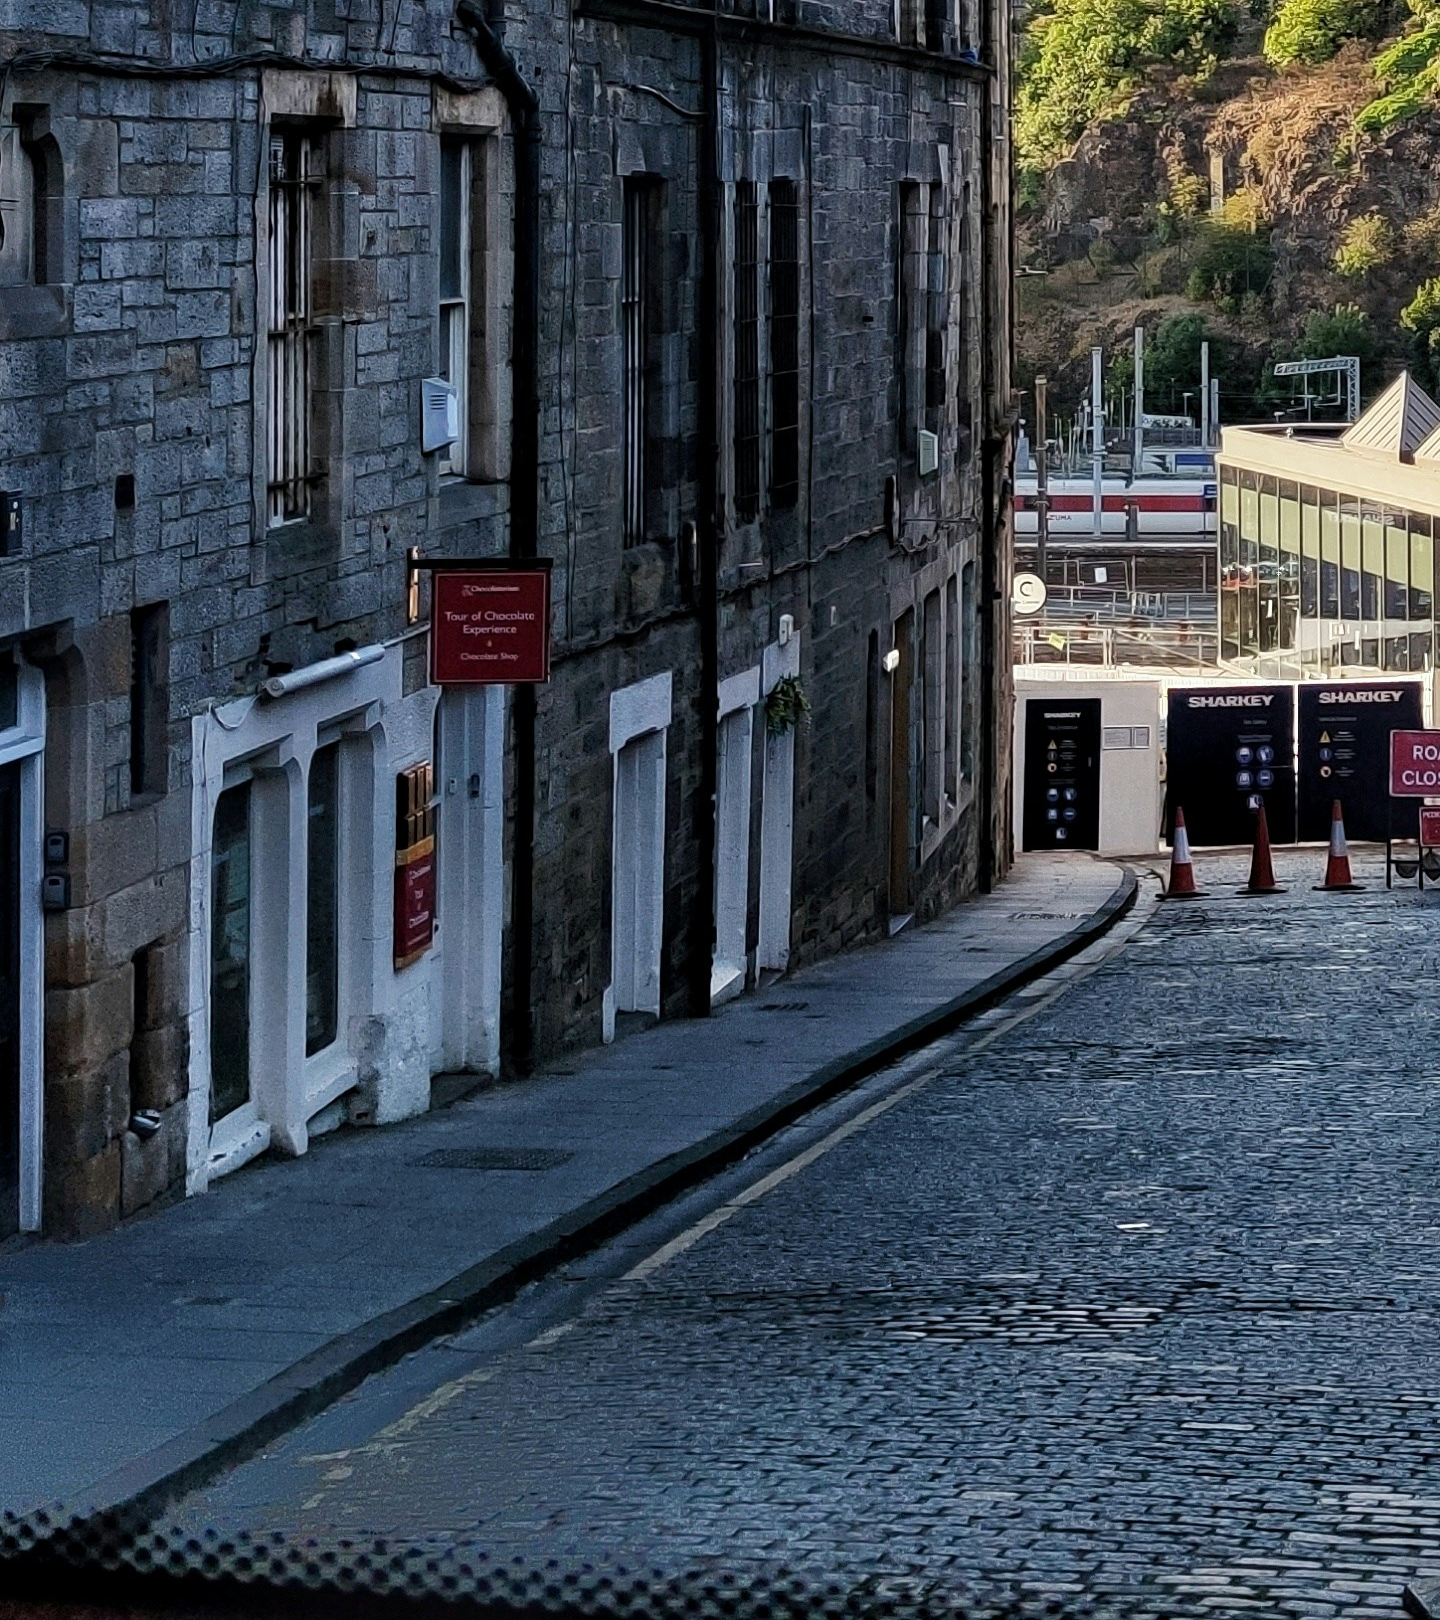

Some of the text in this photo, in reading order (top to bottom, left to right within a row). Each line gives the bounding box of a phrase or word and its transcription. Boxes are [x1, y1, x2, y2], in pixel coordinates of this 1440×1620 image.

[444, 610, 535, 621] Tour of Chocolate
[463, 624, 517, 636] Experience
[1188, 695, 1274, 708] SHARKEY
[1318, 691, 1404, 704] SHARKEY
